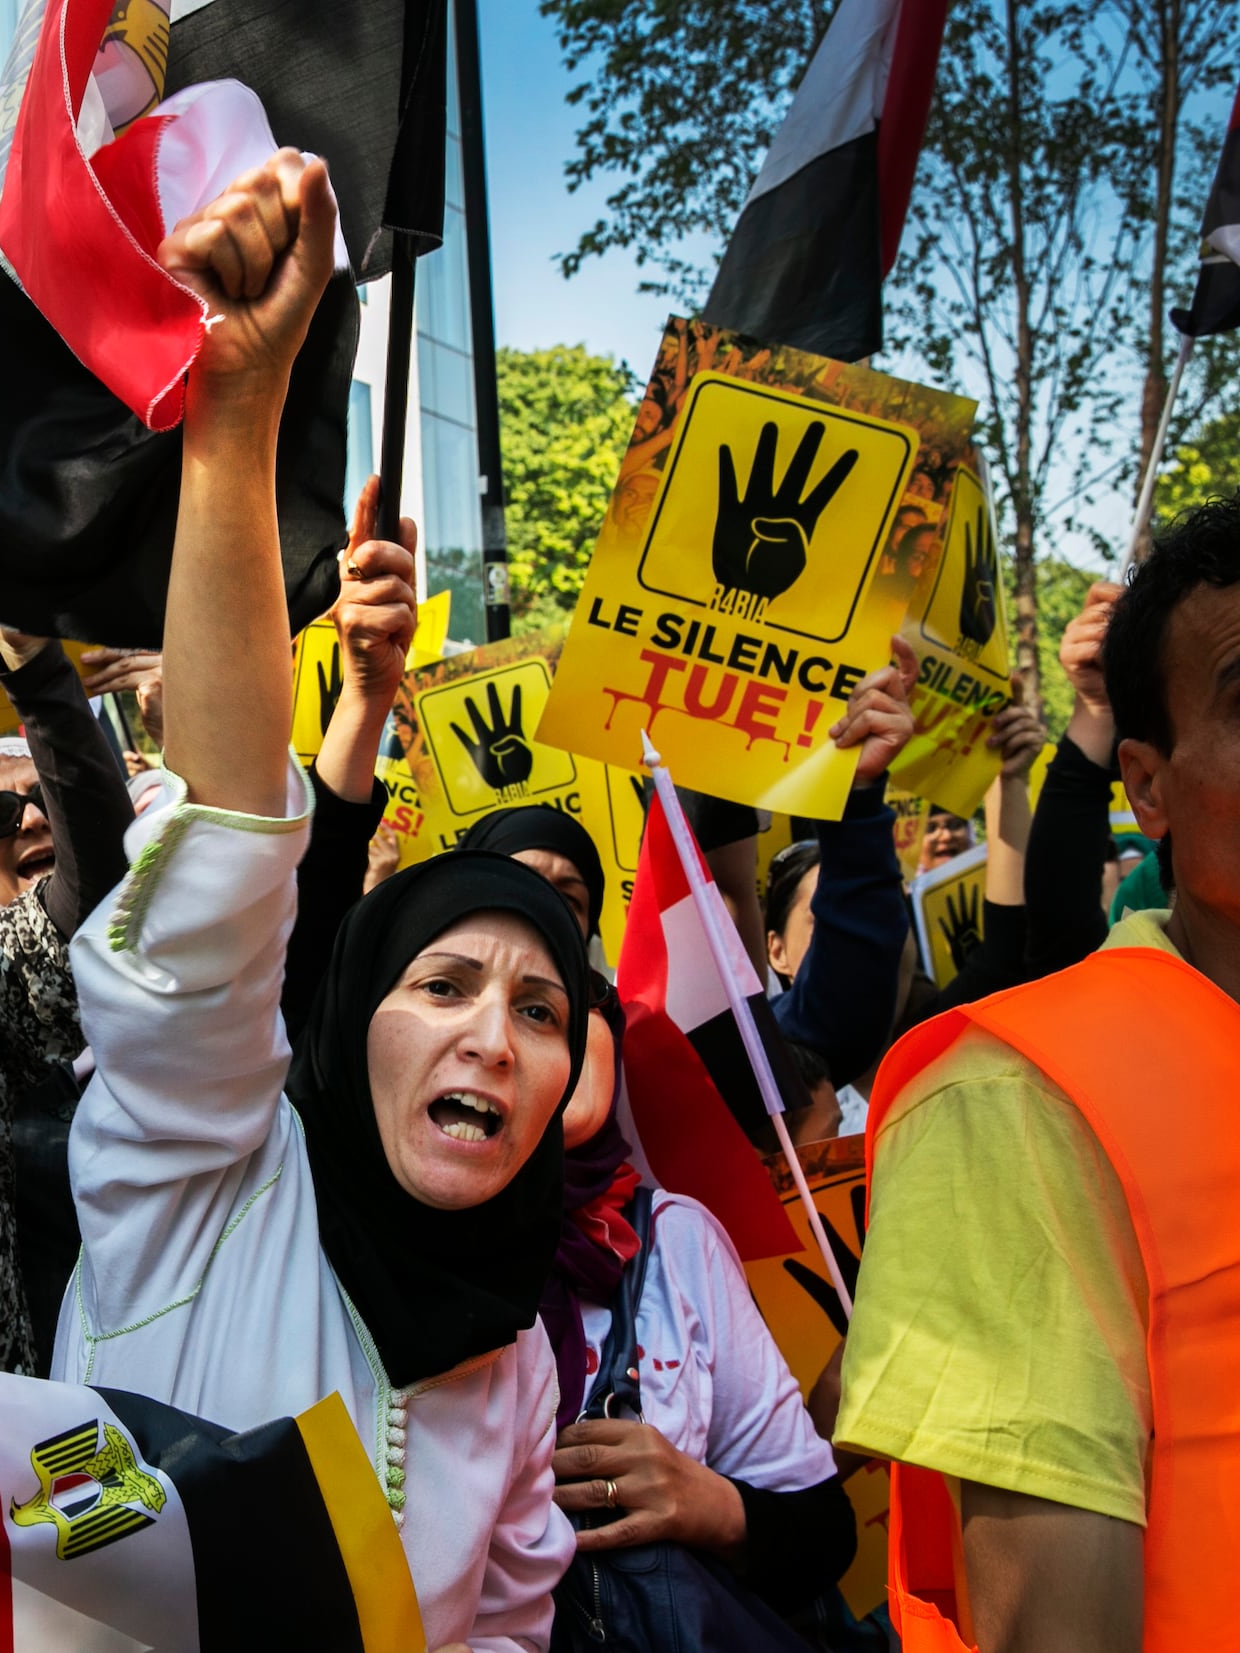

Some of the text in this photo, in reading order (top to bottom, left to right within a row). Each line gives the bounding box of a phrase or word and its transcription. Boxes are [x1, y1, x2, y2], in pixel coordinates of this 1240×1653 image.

[709, 582, 767, 624] R4BIA
[587, 597, 867, 702] LE SILENCE
[917, 655, 1013, 717] SILENC
[639, 648, 789, 743] TUE
